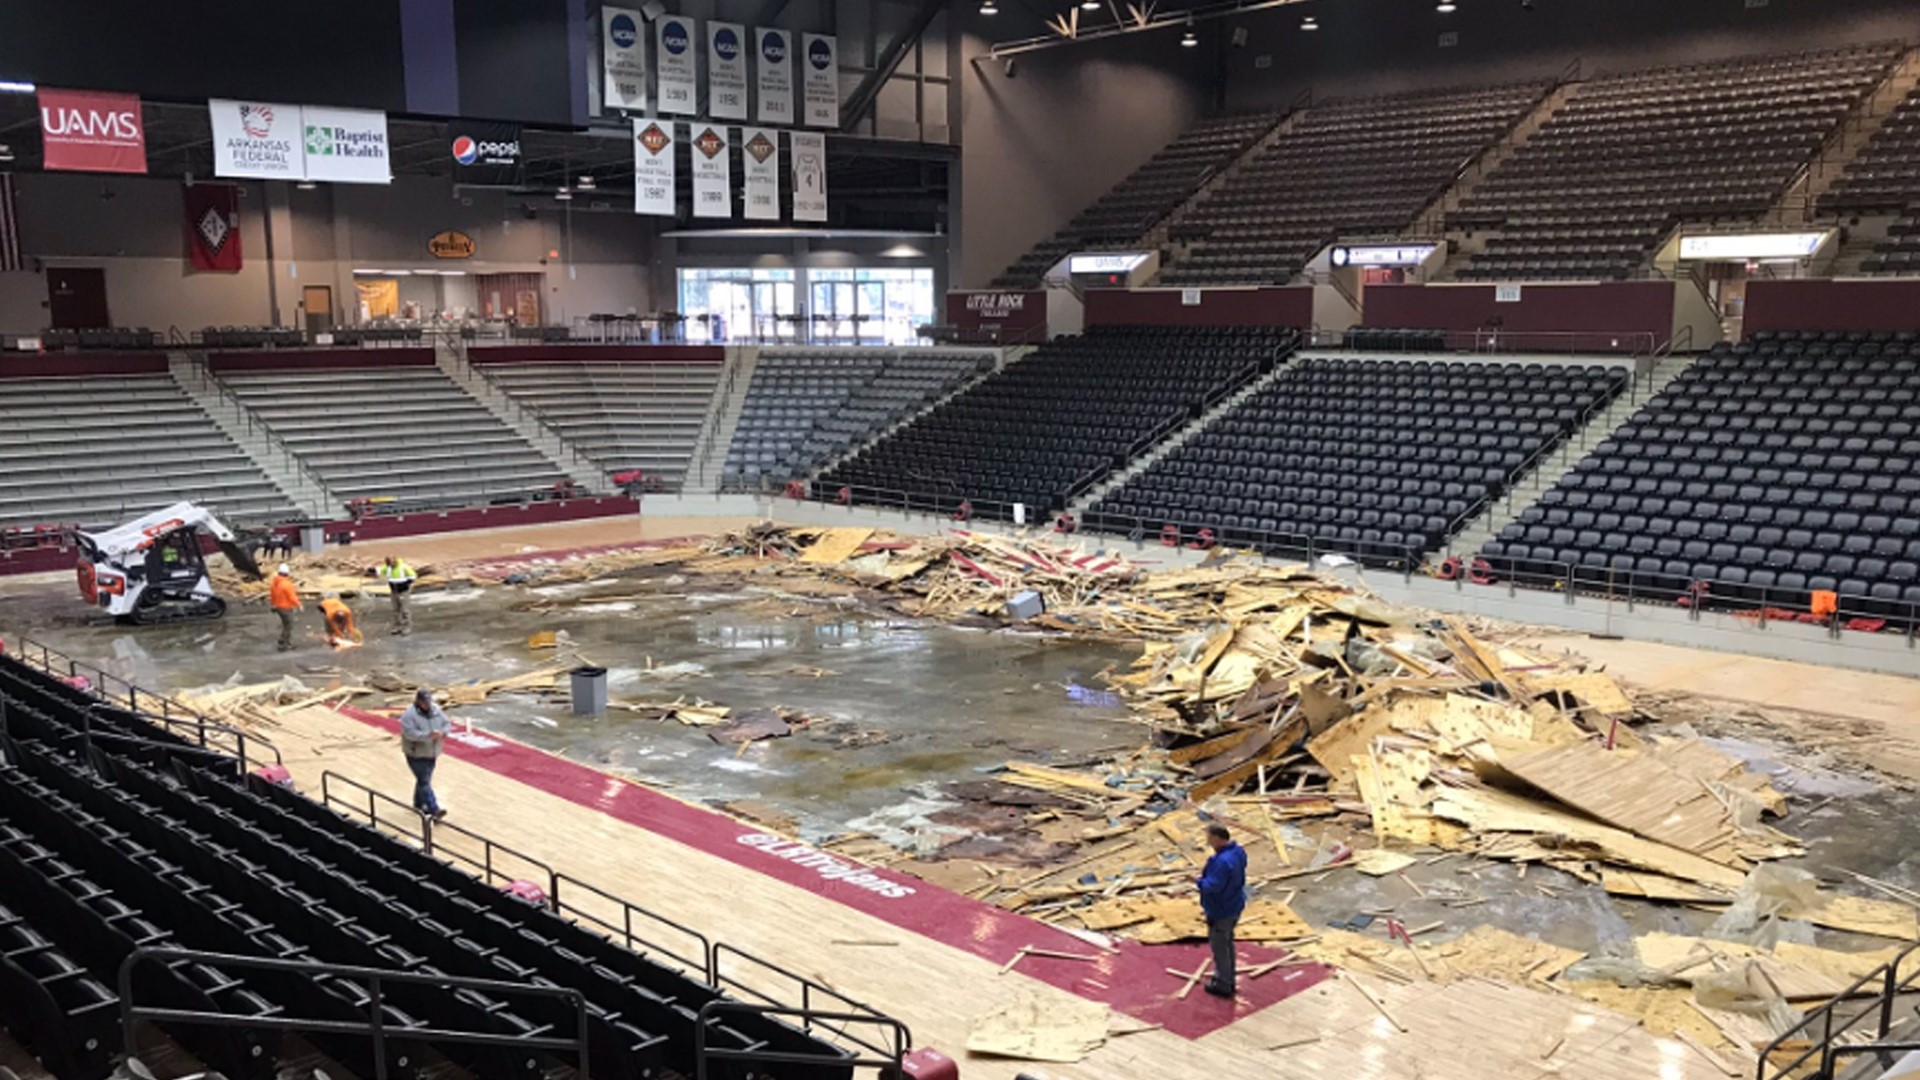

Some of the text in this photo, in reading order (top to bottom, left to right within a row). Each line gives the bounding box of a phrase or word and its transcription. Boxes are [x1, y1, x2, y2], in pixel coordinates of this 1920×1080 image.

[41, 106, 138, 139] UAMS
[334, 127, 384, 145] Baptist
[226, 138, 291, 152] ARKANSAS
[335, 143, 383, 158] Health
[478, 141, 520, 157] pepsi
[232, 149, 288, 164] FEDERAL
[966, 294, 1025, 309] LITTLE ROCK
